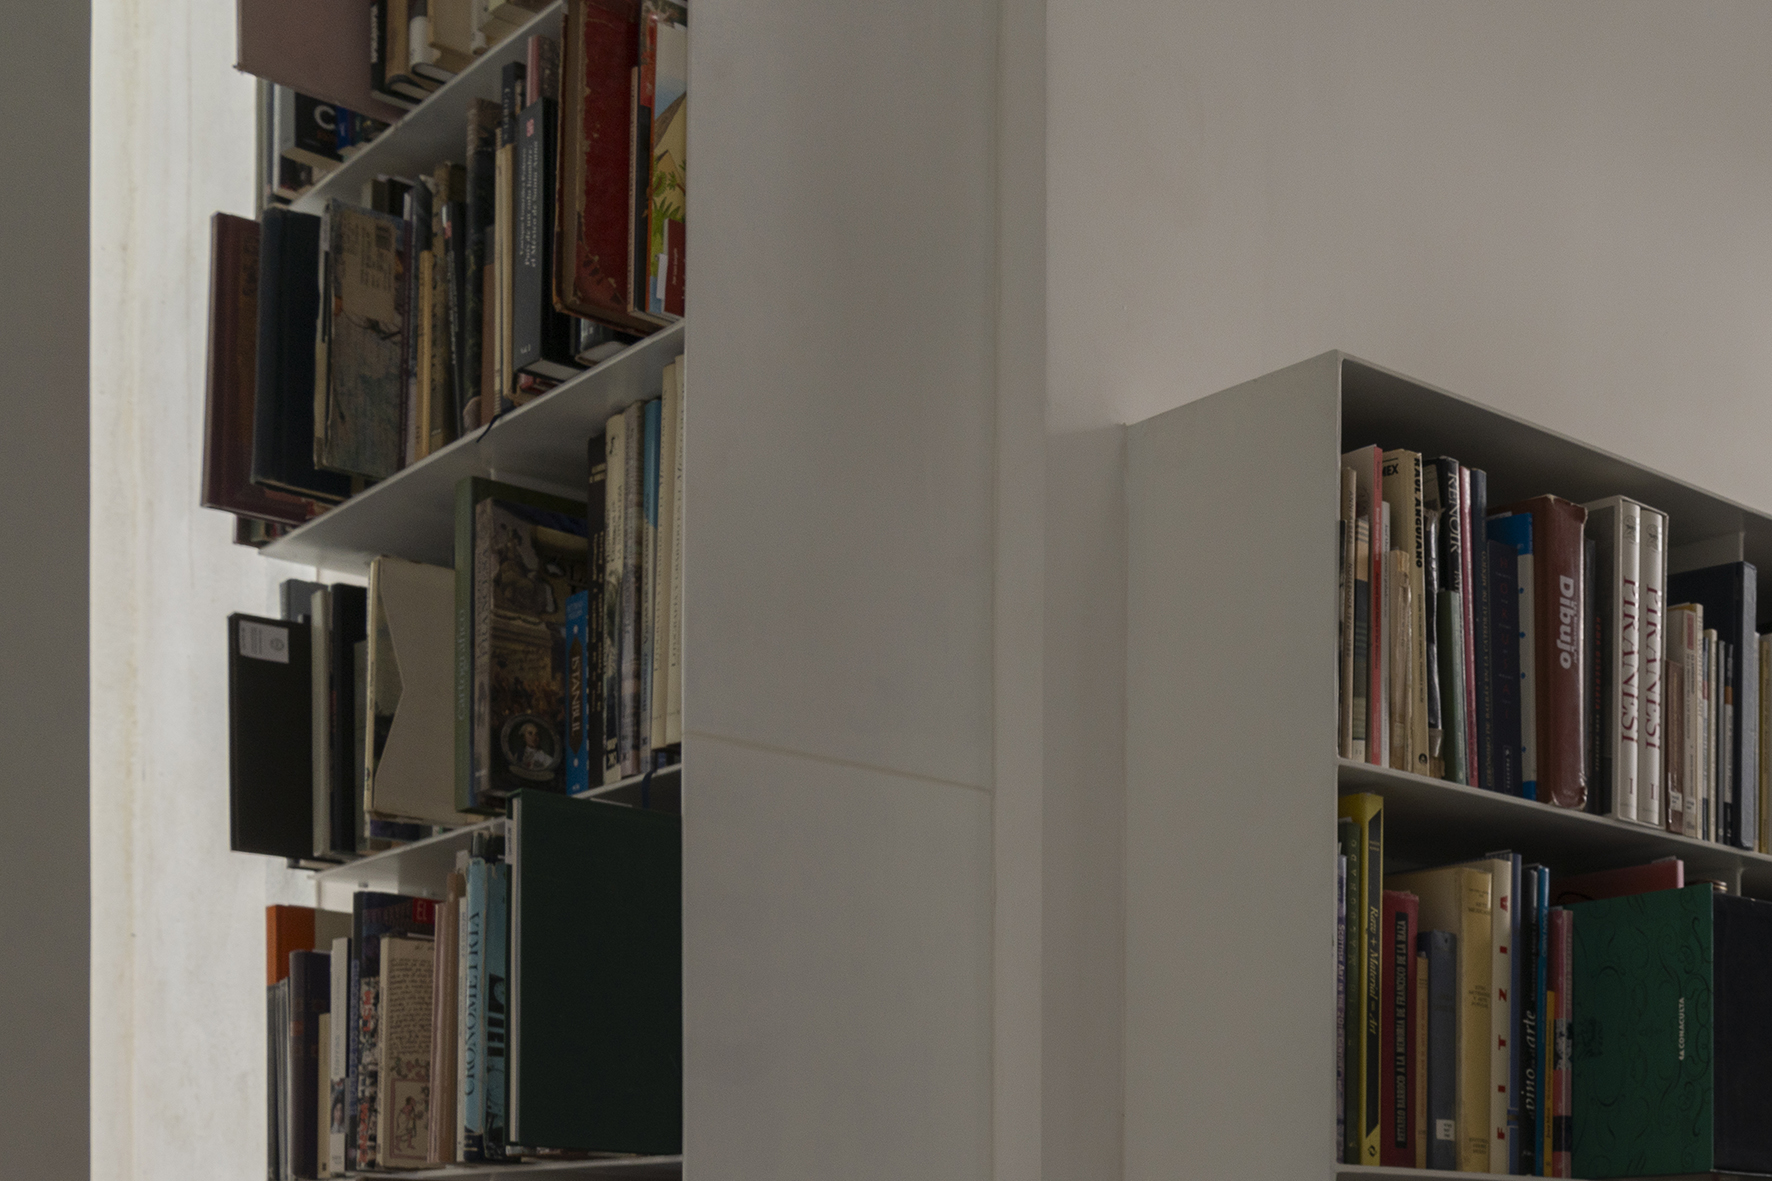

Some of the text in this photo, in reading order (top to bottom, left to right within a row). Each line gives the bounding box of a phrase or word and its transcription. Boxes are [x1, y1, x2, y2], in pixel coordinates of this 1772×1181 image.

[1413, 498, 1424, 569] ANGUIANO
[1447, 471, 1460, 554] RENOIR
[1556, 574, 1575, 670] Dibujo
[1622, 576, 1639, 744] PIRANESI
[1645, 584, 1660, 750] PIRANESI
[570, 655, 582, 738] ISTANBUL
[1368, 905, 1379, 936] Raw
[1368, 949, 1379, 988] Material
[1396, 943, 1406, 954] LA
[1396, 954, 1406, 966] DE
[1396, 967, 1406, 1006] FRANCISCO
[1368, 1003, 1379, 1026] Art
[1677, 996, 1685, 1050] CONACULTA
[1396, 1056, 1406, 1066] LA
[1520, 1009, 1537, 1111] vino arte
